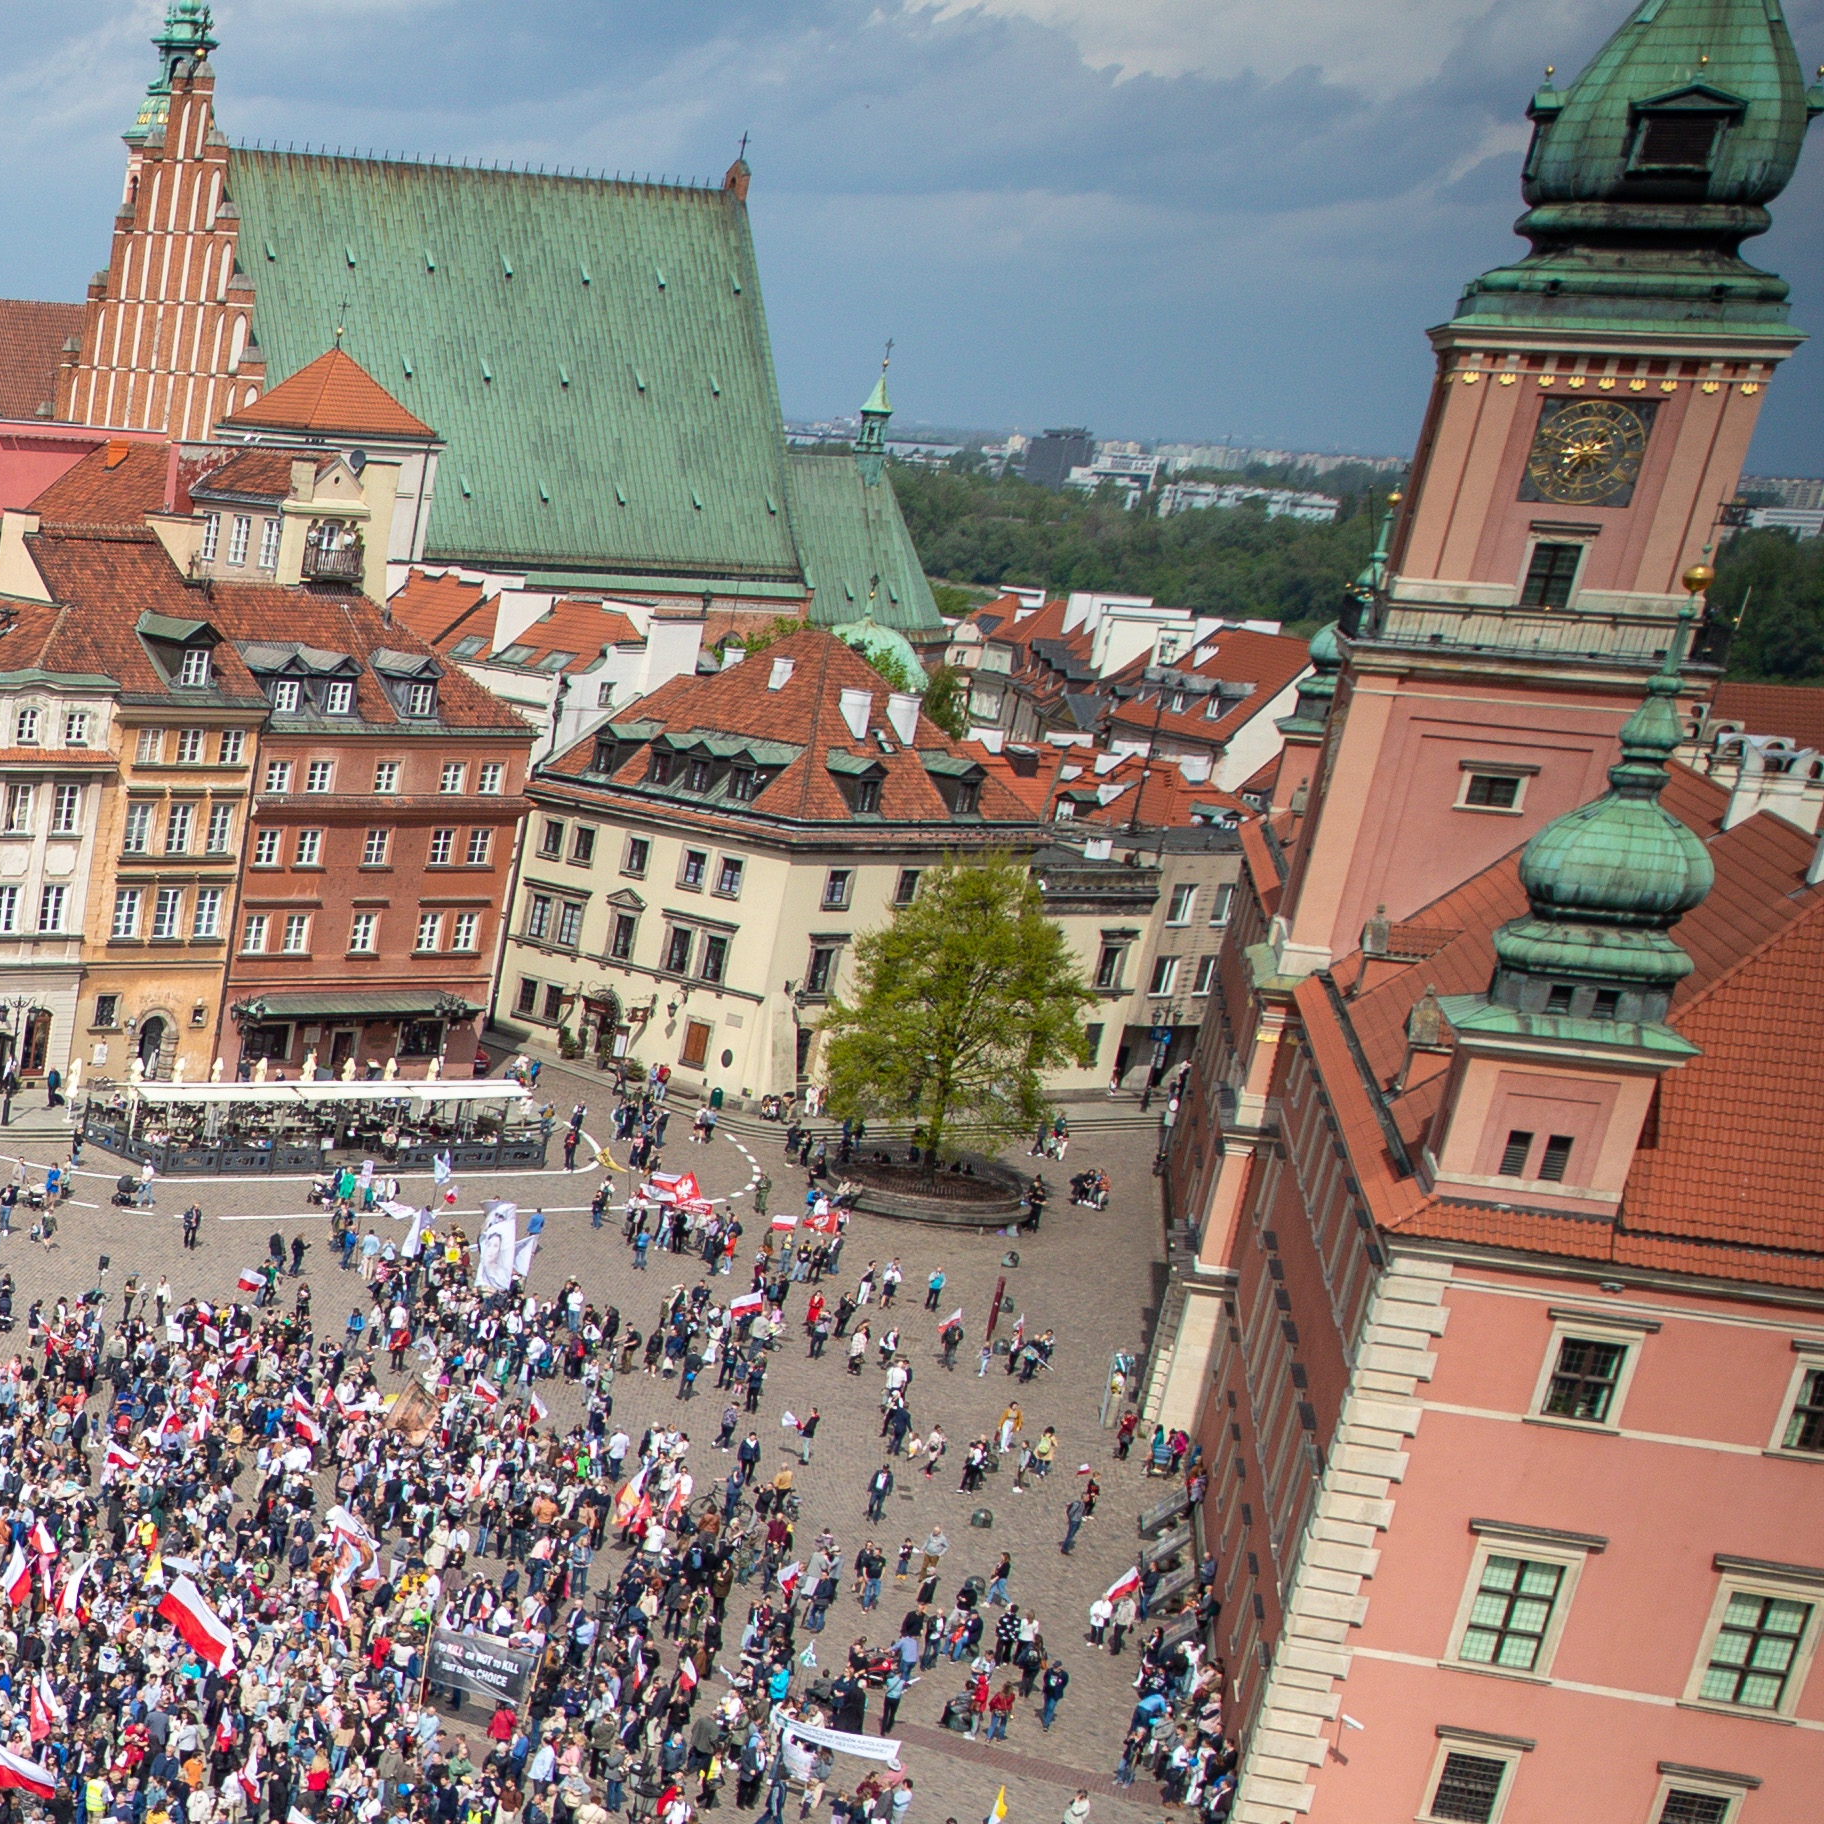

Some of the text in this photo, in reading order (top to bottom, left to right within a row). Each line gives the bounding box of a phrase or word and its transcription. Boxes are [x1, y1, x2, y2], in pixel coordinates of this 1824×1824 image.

[446, 1643, 464, 1657] KILL
[475, 1652, 492, 1666] NOT
[502, 1660, 520, 1674] KILL
[475, 1668, 509, 1687] CHOICE
